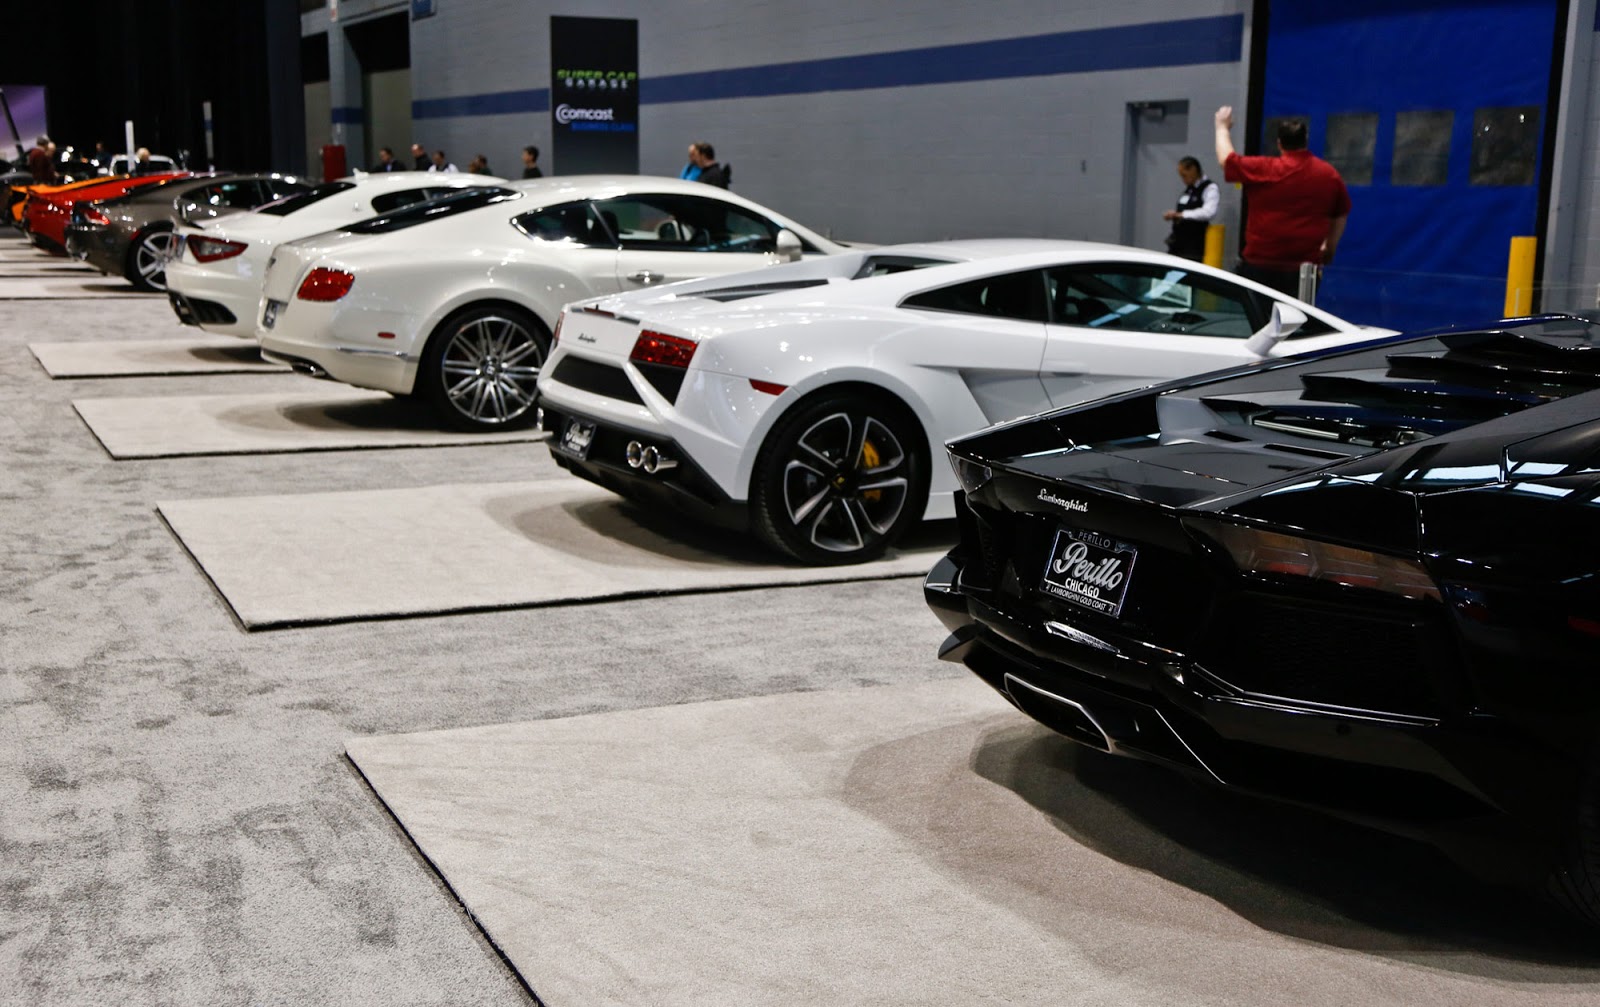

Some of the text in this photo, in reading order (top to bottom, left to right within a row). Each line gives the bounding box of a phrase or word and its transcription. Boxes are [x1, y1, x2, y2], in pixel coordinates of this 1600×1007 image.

[1037, 488, 1088, 512] Lamborghini
[1078, 531, 1111, 549] PERILLO
[1052, 541, 1123, 591] Perillo
[1050, 586, 1080, 602] LAMBORGHINI
[1079, 593, 1093, 606] GOLD
[1064, 577, 1100, 600] CHICAGO
